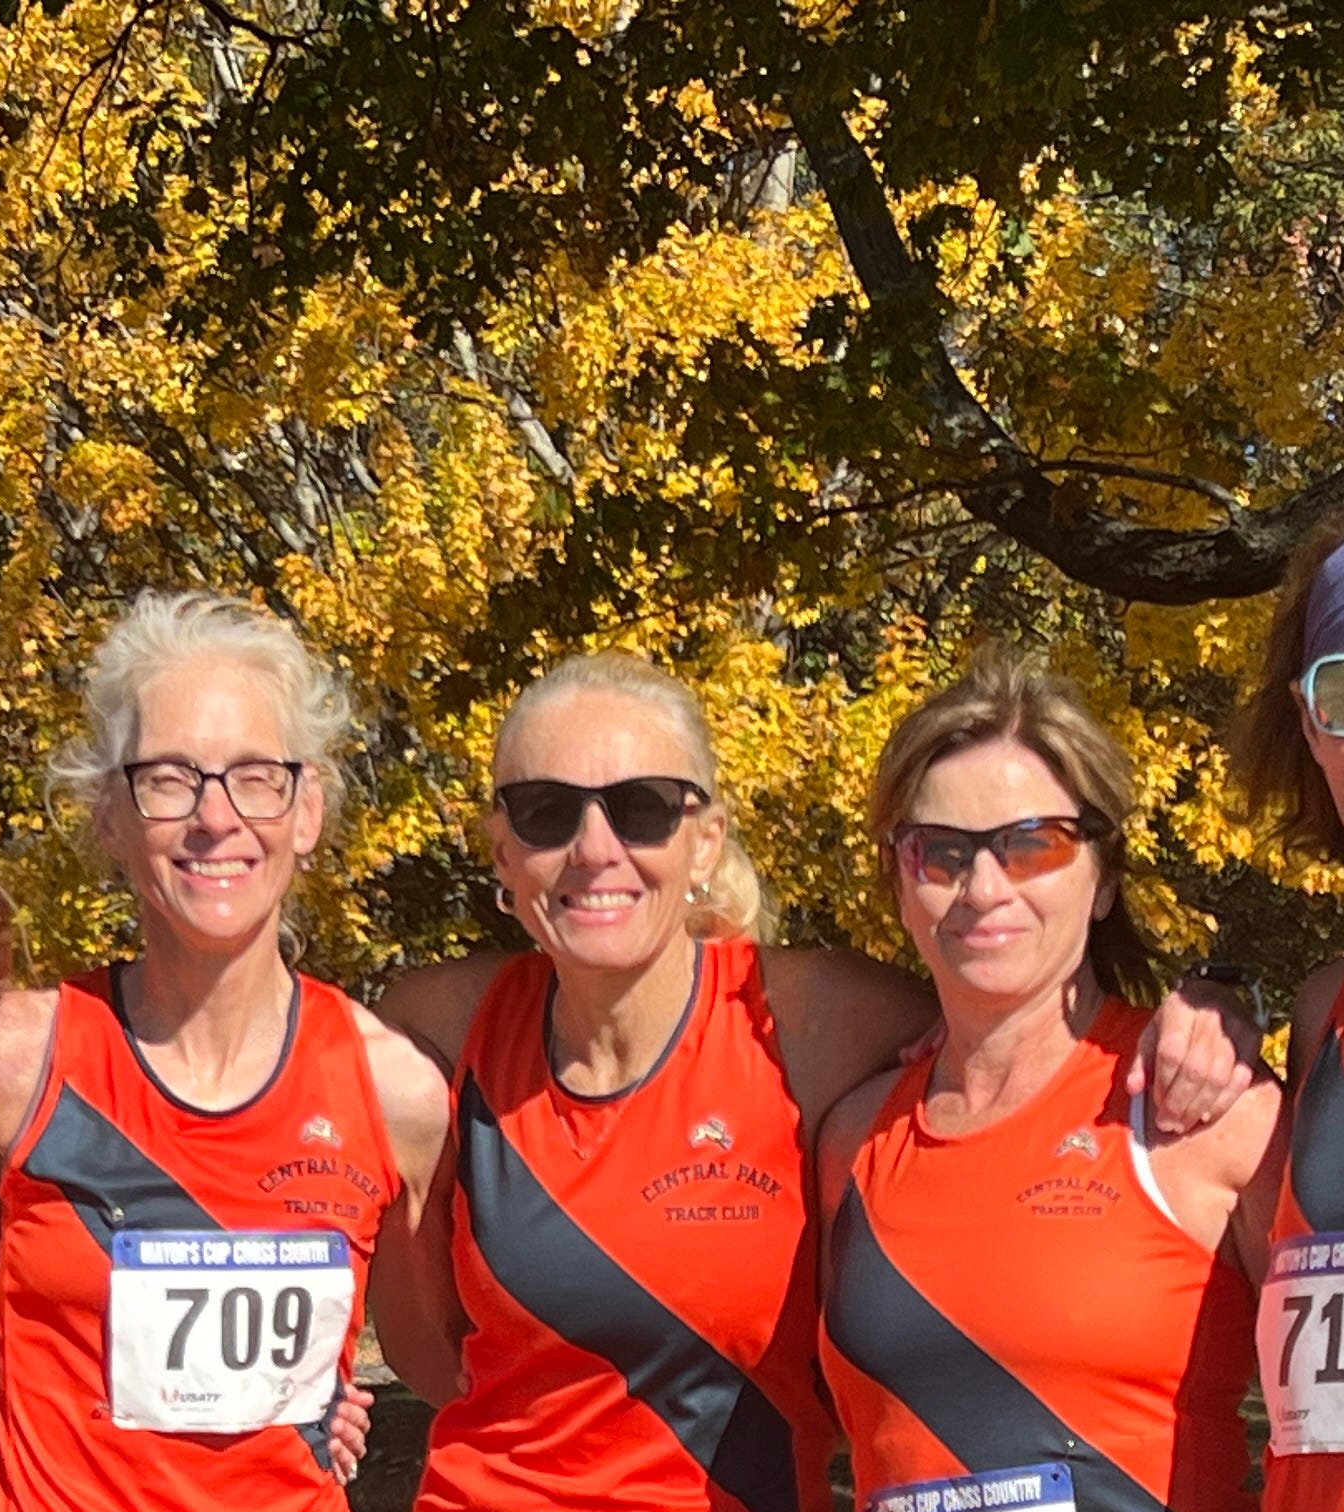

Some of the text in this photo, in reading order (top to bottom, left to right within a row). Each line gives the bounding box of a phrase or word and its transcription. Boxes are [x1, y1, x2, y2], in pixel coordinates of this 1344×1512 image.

[258, 1158, 380, 1201] CENTRAL PARK
[641, 1162, 782, 1202] CENTRAL PARK
[1016, 1177, 1122, 1205] CENTRAL PARK
[284, 1200, 328, 1214] TRACK
[664, 1205, 759, 1221] TRACK CLUB
[1031, 1206, 1069, 1216] TRACK
[203, 1241, 231, 1265] CUP
[233, 1241, 277, 1265] CROSS
[279, 1241, 330, 1265] COUNTRY
[164, 1286, 314, 1372] 709
[943, 1484, 982, 1512] CROSS
[984, 1475, 1041, 1506] COUNTRY
